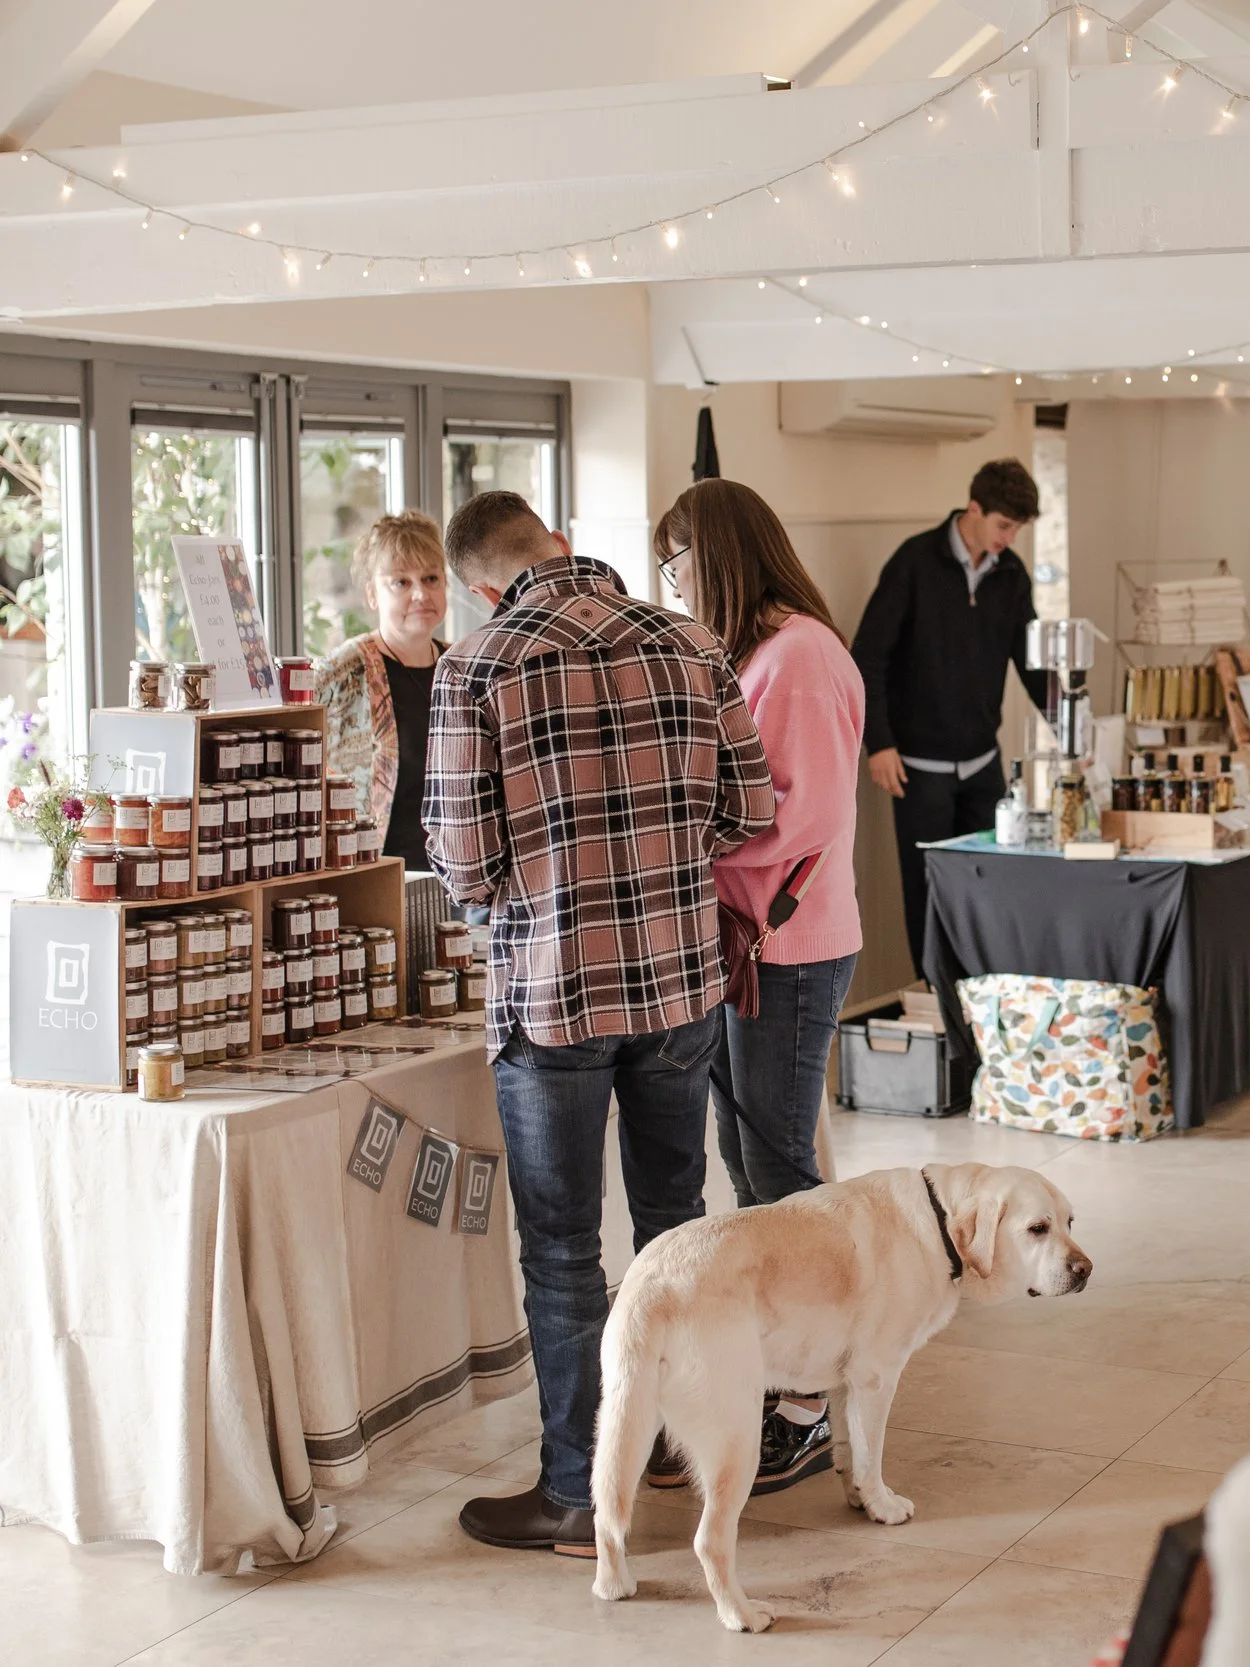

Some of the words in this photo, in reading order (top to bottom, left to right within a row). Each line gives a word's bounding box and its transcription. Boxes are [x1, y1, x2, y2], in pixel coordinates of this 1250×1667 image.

[188, 574, 206, 585] Echo
[199, 593, 220, 606] £4.00
[207, 615, 225, 627] each
[217, 639, 225, 648] or
[217, 657, 229, 671] for
[38, 1008, 98, 1031] ECHO
[353, 1159, 382, 1185] ECHO
[411, 1198, 439, 1220] ECHO
[461, 1215, 487, 1229] ECHO
